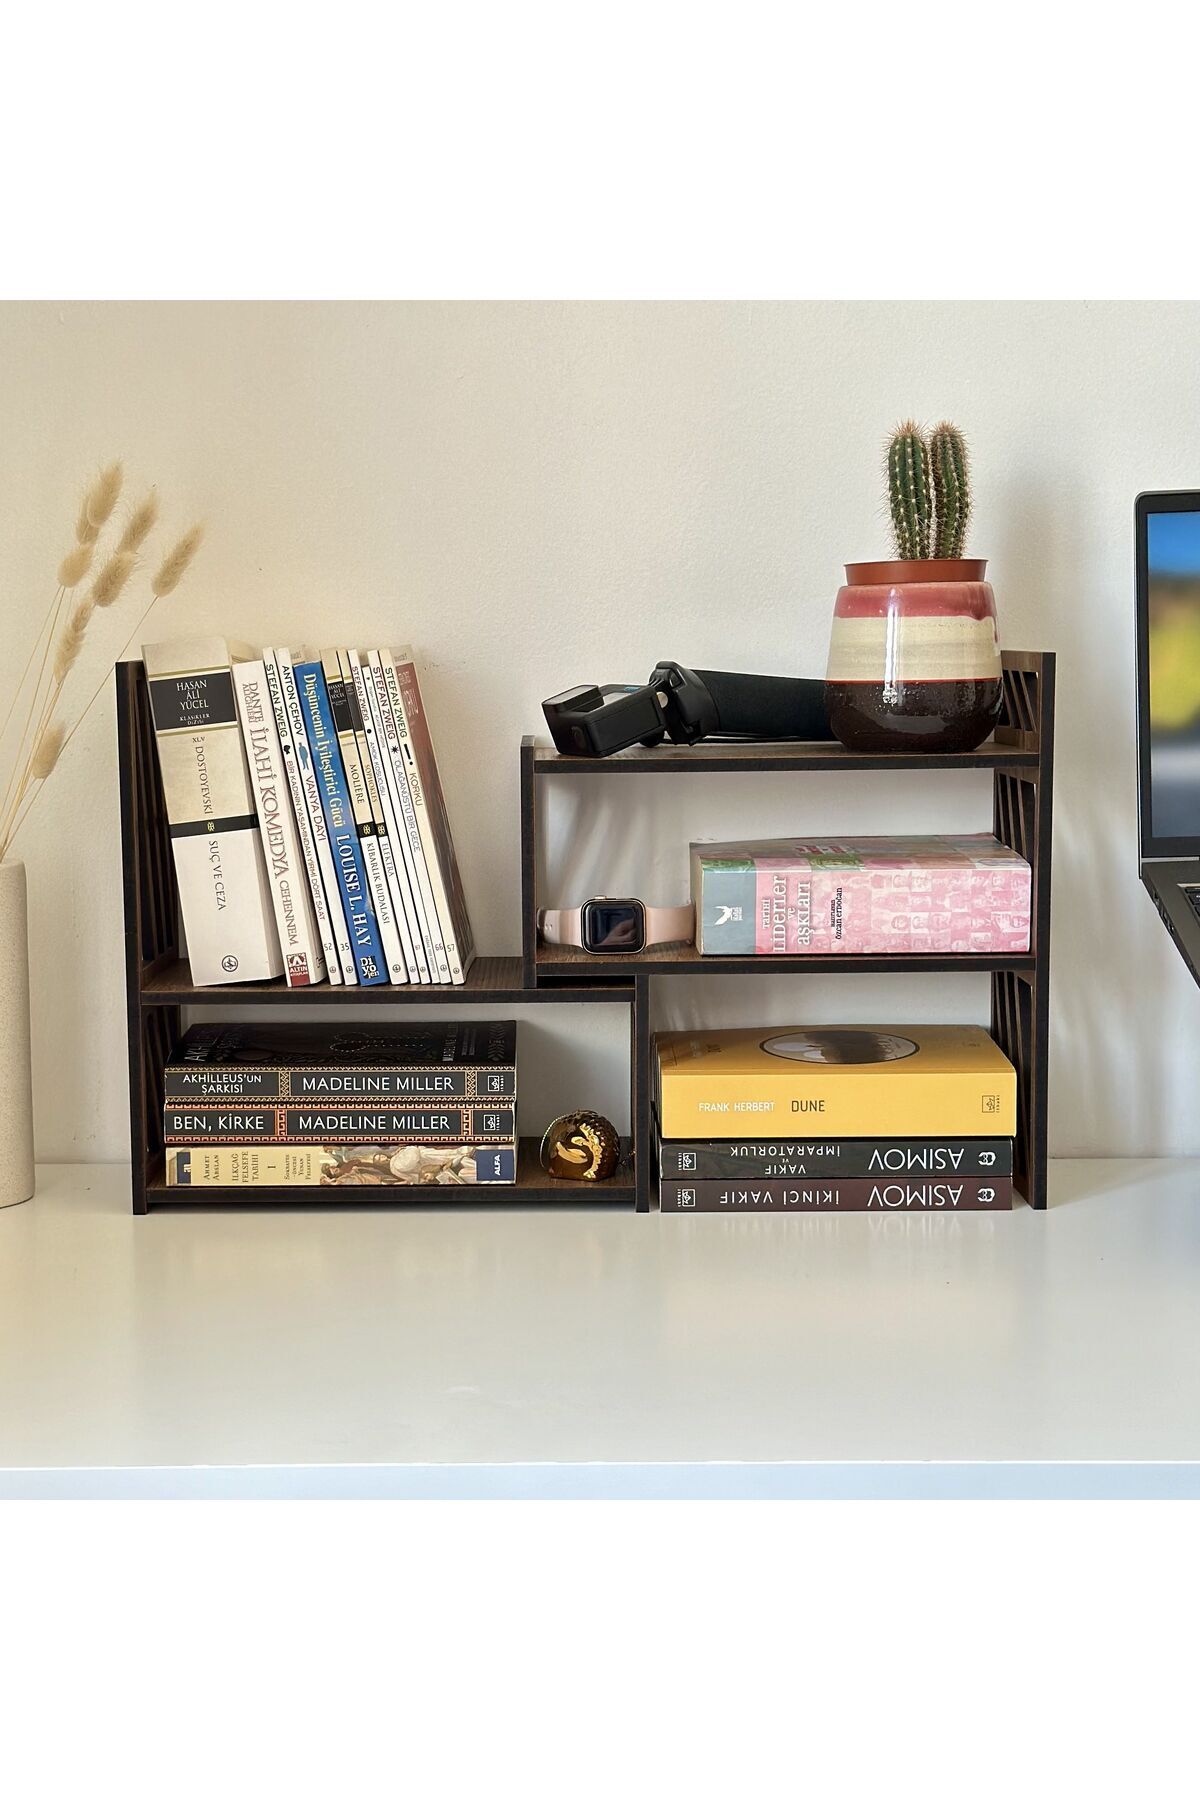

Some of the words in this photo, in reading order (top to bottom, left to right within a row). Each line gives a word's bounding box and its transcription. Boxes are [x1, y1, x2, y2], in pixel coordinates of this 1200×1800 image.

[176, 679, 207, 692] HASAN
[352, 666, 362, 696] STEFAN
[358, 697, 369, 721] ZWEIG
[180, 699, 209, 710] YÜCEL
[249, 681, 264, 722] DANTE
[265, 663, 281, 707] STEFAN
[275, 706, 288, 738] ZWEIG
[282, 665, 296, 700] ANTON
[290, 701, 304, 736] ÇEHOV
[373, 666, 388, 708] STEFAN
[382, 708, 397, 740] ZWEIG
[385, 667, 400, 706] STEFAN
[394, 706, 408, 738] ZWEIG
[250, 727, 277, 782] İLAHİ
[303, 673, 327, 741] Düşüncenin
[318, 740, 340, 795] İyileştirici
[329, 797, 346, 827] Gücü
[370, 742, 378, 760] AMOK
[290, 774, 302, 805] KADININ
[365, 764, 378, 803] SOPHOKLES
[409, 772, 423, 806] KORKU
[305, 775, 320, 813] VANYA
[313, 816, 326, 840] DAYI
[394, 760, 411, 814] OLAĞANÜSTÜ
[410, 831, 420, 852] GECE
[260, 785, 289, 879] KOMEDYA
[295, 806, 311, 857] YAŞAMINDAN
[209, 840, 221, 863] SUÇ
[382, 843, 395, 877] ELEKTRA
[213, 865, 223, 879] VE
[336, 835, 360, 893] LOUISE
[310, 878, 321, 899] DÖRT
[367, 842, 381, 881] KİBARLIK
[375, 881, 390, 924] BUDALASI
[215, 881, 226, 910] CEZA
[349, 895, 363, 910] L.
[279, 880, 299, 946] CEHENNEM
[315, 900, 325, 920] SAAT
[352, 913, 372, 946] HAY
[323, 943, 332, 951] 52
[340, 942, 350, 951] 35
[447, 943, 455, 952] 57
[202, 1084, 243, 1096] ŞARKISI
[303, 1077, 390, 1090] MADELINE
[396, 1077, 454, 1090] MILLER
[698, 1102, 729, 1111] FRANK
[734, 1101, 775, 1111] HERBERT
[791, 1100, 825, 1112] DUNE
[173, 1116, 212, 1132] BEN,
[218, 1113, 264, 1130] KİRKE
[299, 1116, 386, 1130] MADELINE
[392, 1116, 450, 1130] MILLER
[730, 1145, 840, 1157] İMPARATORLUK
[867, 1148, 964, 1170] ASIMOV
[251, 1154, 259, 1181] TARİHİ
[765, 1164, 806, 1175] VAKIF
[720, 1191, 773, 1204] VAKIF
[783, 1190, 839, 1205] İKİNCİ
[867, 1184, 963, 1207] ASIMOV
